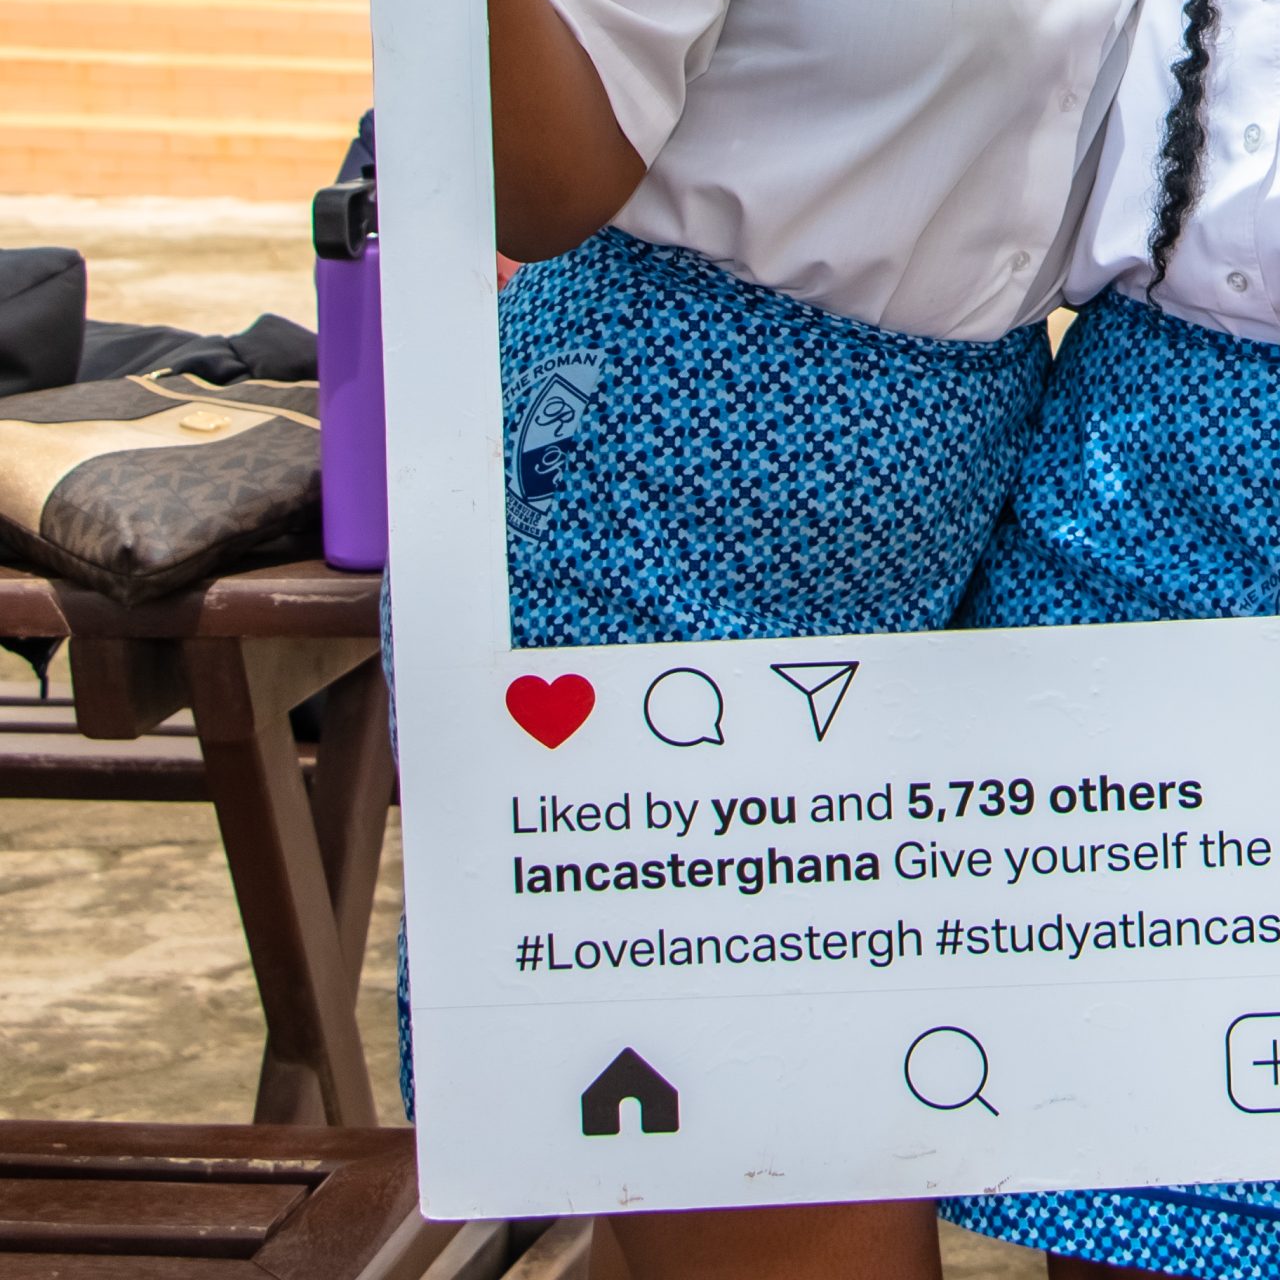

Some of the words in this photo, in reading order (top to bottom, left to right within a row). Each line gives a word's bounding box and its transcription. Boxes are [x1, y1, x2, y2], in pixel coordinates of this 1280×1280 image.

[503, 373, 531, 402] THE
[533, 352, 598, 379] ROMAN
[512, 792, 631, 834] Liked
[646, 791, 699, 838] by
[710, 794, 797, 836] you
[810, 782, 893, 823] and
[908, 778, 1035, 823] 5,739
[1049, 774, 1203, 814] others
[514, 840, 880, 894] lancasterghana
[894, 840, 992, 880] Give
[1004, 830, 1188, 885] yourself
[1199, 830, 1272, 868] the
[515, 919, 923, 972] #Lovelancastergh
